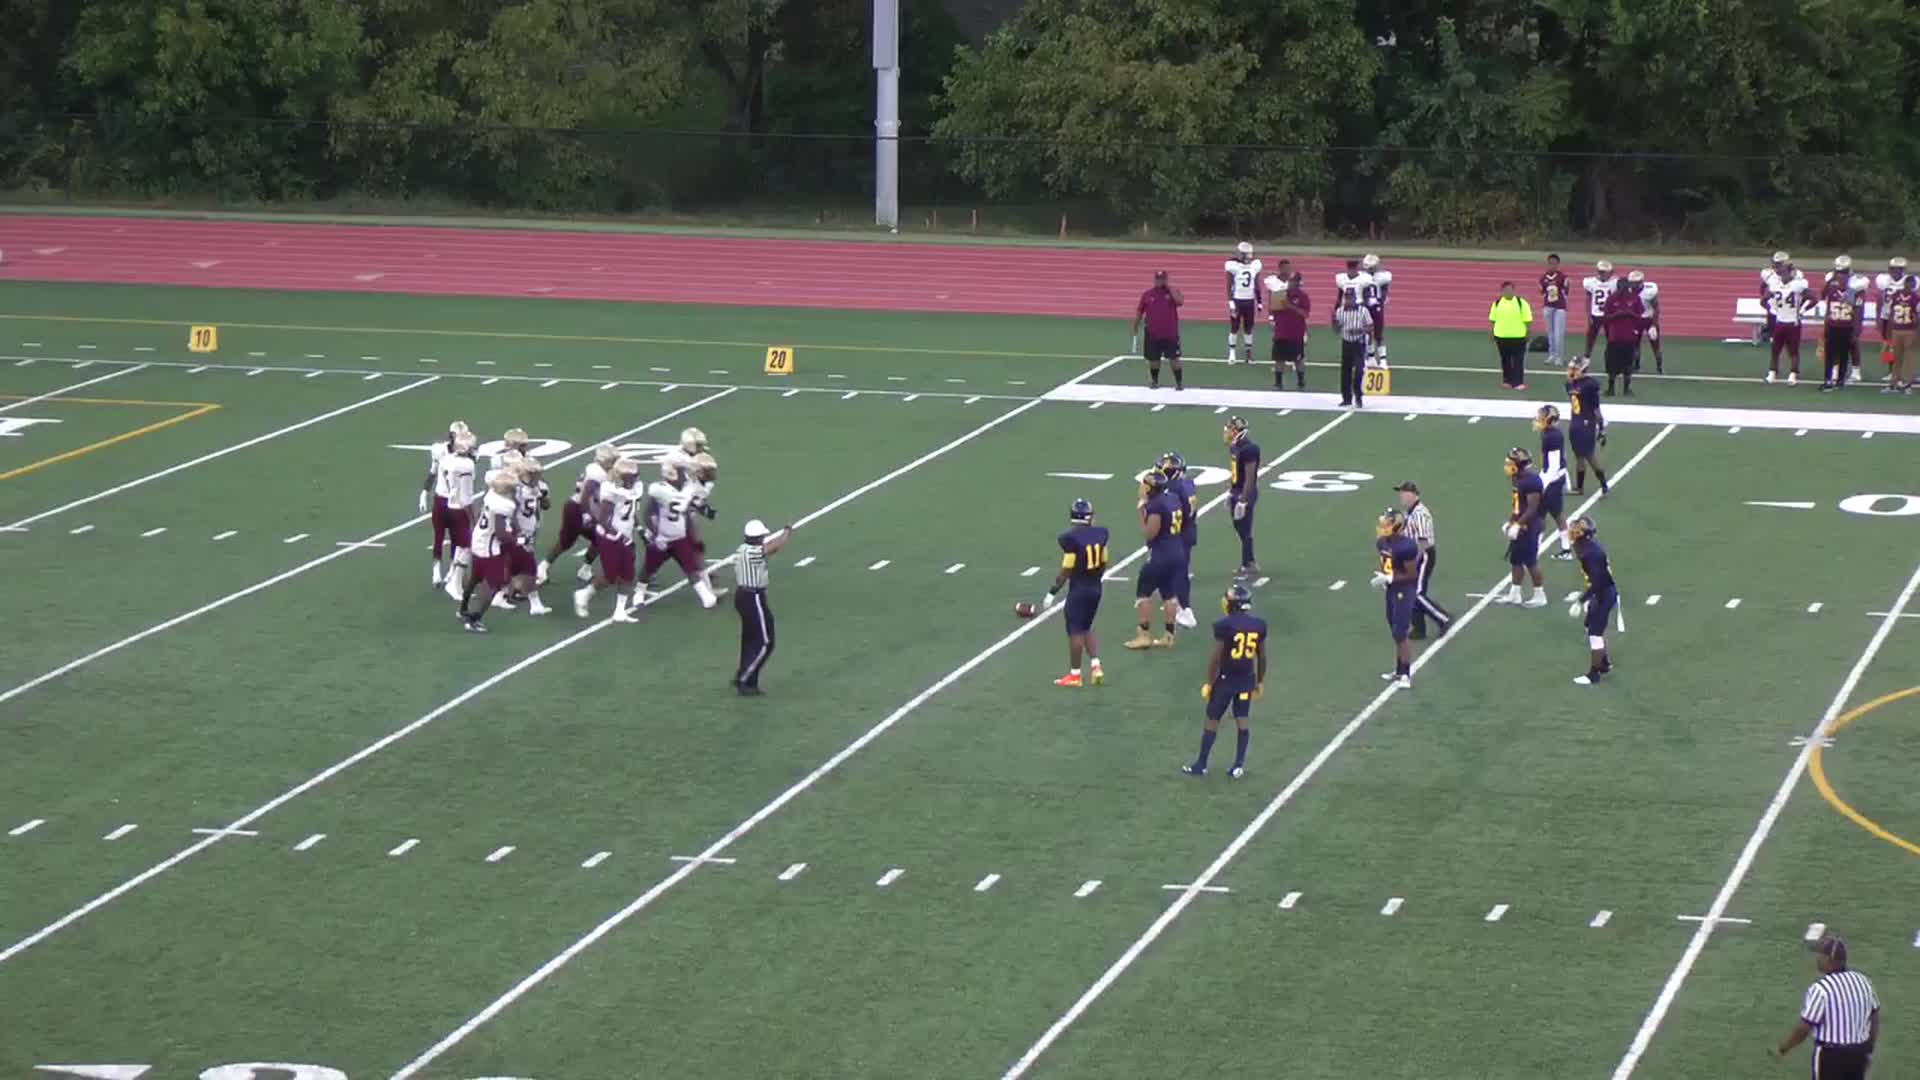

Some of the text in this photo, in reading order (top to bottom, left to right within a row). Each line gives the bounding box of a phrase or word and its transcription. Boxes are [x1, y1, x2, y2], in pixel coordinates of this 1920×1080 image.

[1241, 270, 1252, 288] 3
[1772, 291, 1797, 309] 24
[1829, 300, 1852, 321] 52
[195, 329, 211, 348] 10
[769, 350, 787, 369] 20
[1366, 371, 1384, 391] 30
[1085, 543, 1101, 569] 11
[1230, 632, 1259, 659] 35
